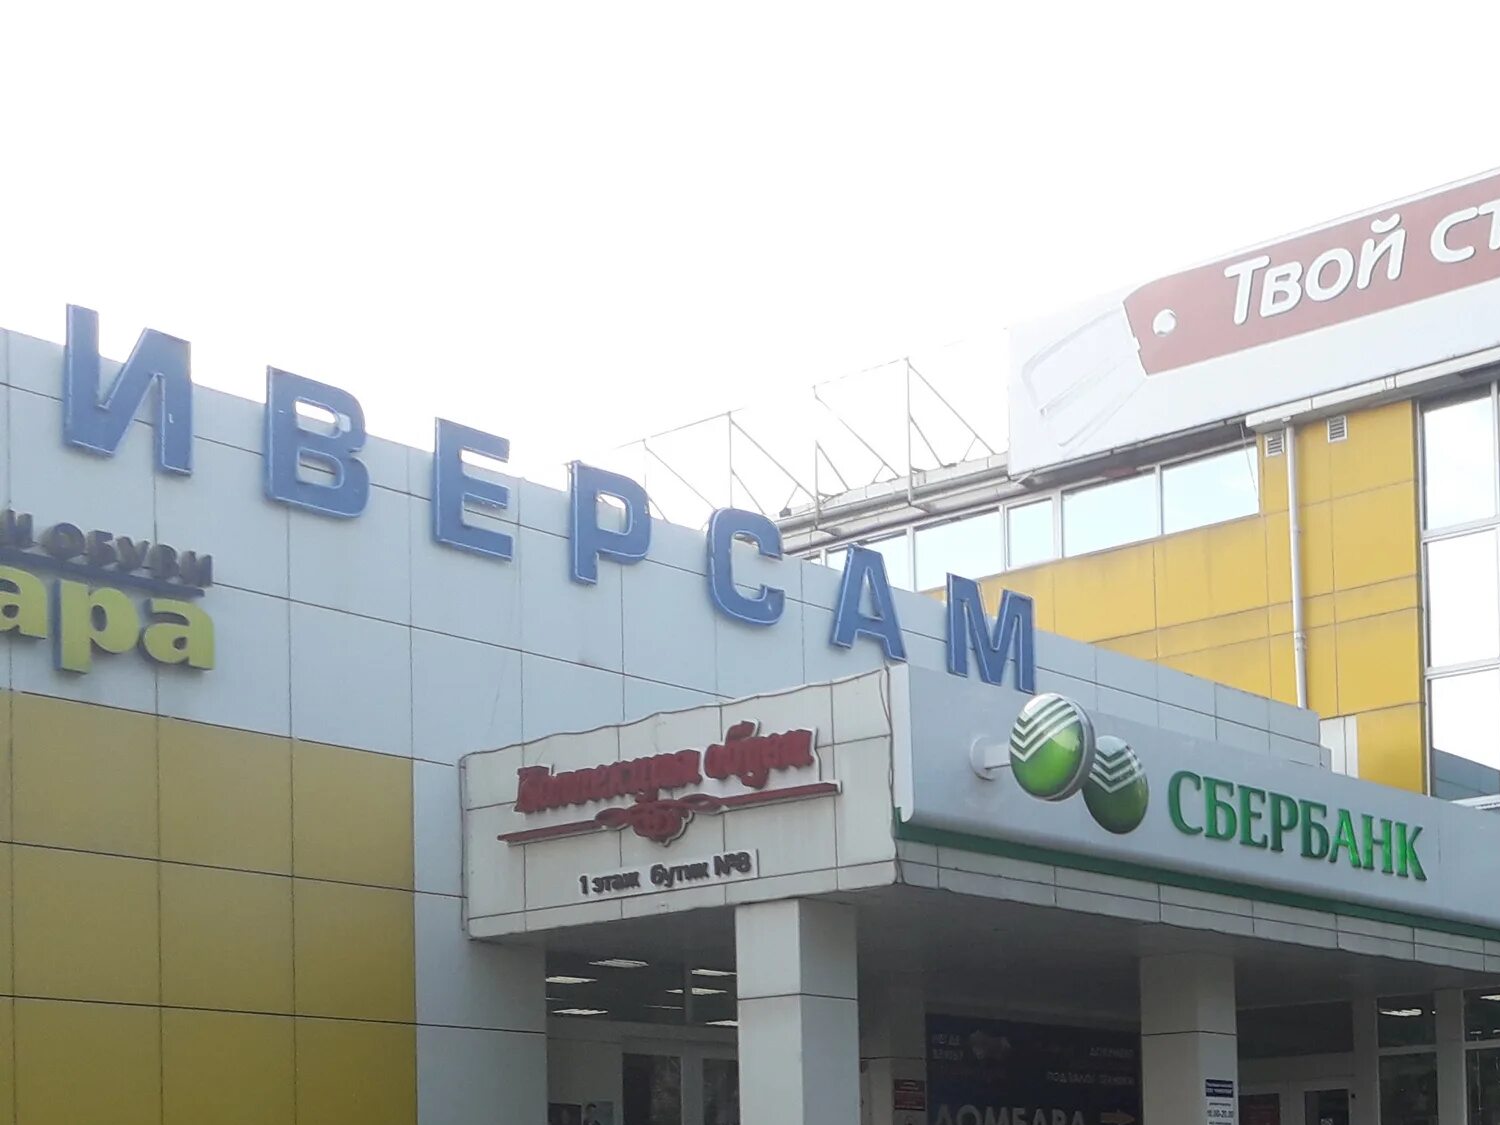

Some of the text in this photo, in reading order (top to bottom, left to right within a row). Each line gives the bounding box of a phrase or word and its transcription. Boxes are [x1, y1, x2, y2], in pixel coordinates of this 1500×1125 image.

[1224, 214, 1409, 326] Твой
[579, 851, 753, 895] 1 этаж бутик №8
[1167, 770, 1429, 882] СБЕРБАНК
